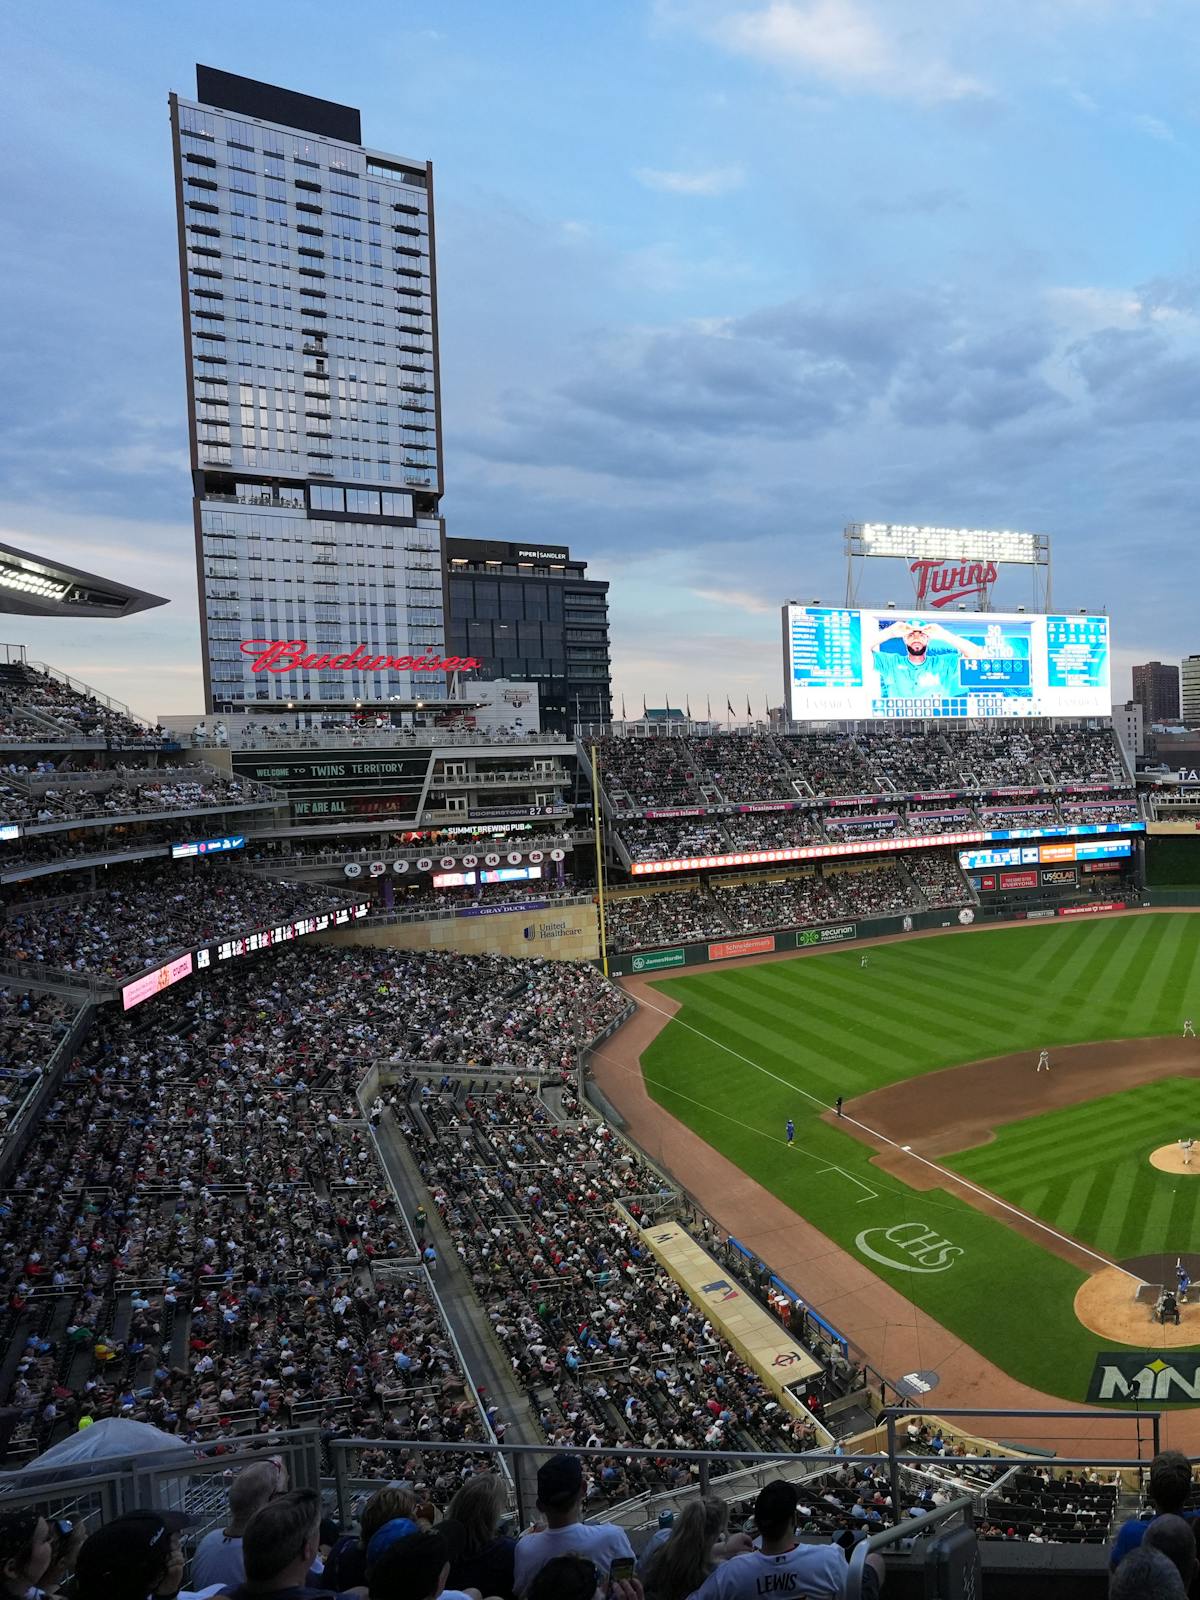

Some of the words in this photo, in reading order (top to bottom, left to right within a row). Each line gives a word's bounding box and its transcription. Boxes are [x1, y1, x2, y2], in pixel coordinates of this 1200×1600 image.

[540, 552, 566, 560] SANDLER
[910, 558, 998, 599] Twins
[240, 639, 482, 674] Budweiser
[256, 768, 290, 777] WELCOME
[310, 765, 345, 777] TWINS
[352, 763, 404, 774] TERRITORY
[295, 803, 309, 814] WE
[312, 802, 328, 813] ARE
[331, 801, 346, 812] ALL
[470, 809, 528, 817] COOPERSTOWN
[529, 807, 542, 816] 27
[652, 810, 682, 818] Treasure
[448, 827, 477, 835] SUMMIT
[477, 825, 510, 833] BREWING
[511, 823, 525, 831] PUB
[480, 906, 502, 915] GRAY
[539, 921, 566, 931] United
[821, 926, 852, 937] securian
[540, 928, 582, 939] Healthcare
[645, 955, 682, 965] JamesHardie
[885, 1222, 965, 1266] CHS
[756, 1573, 797, 1596] LEWIS
